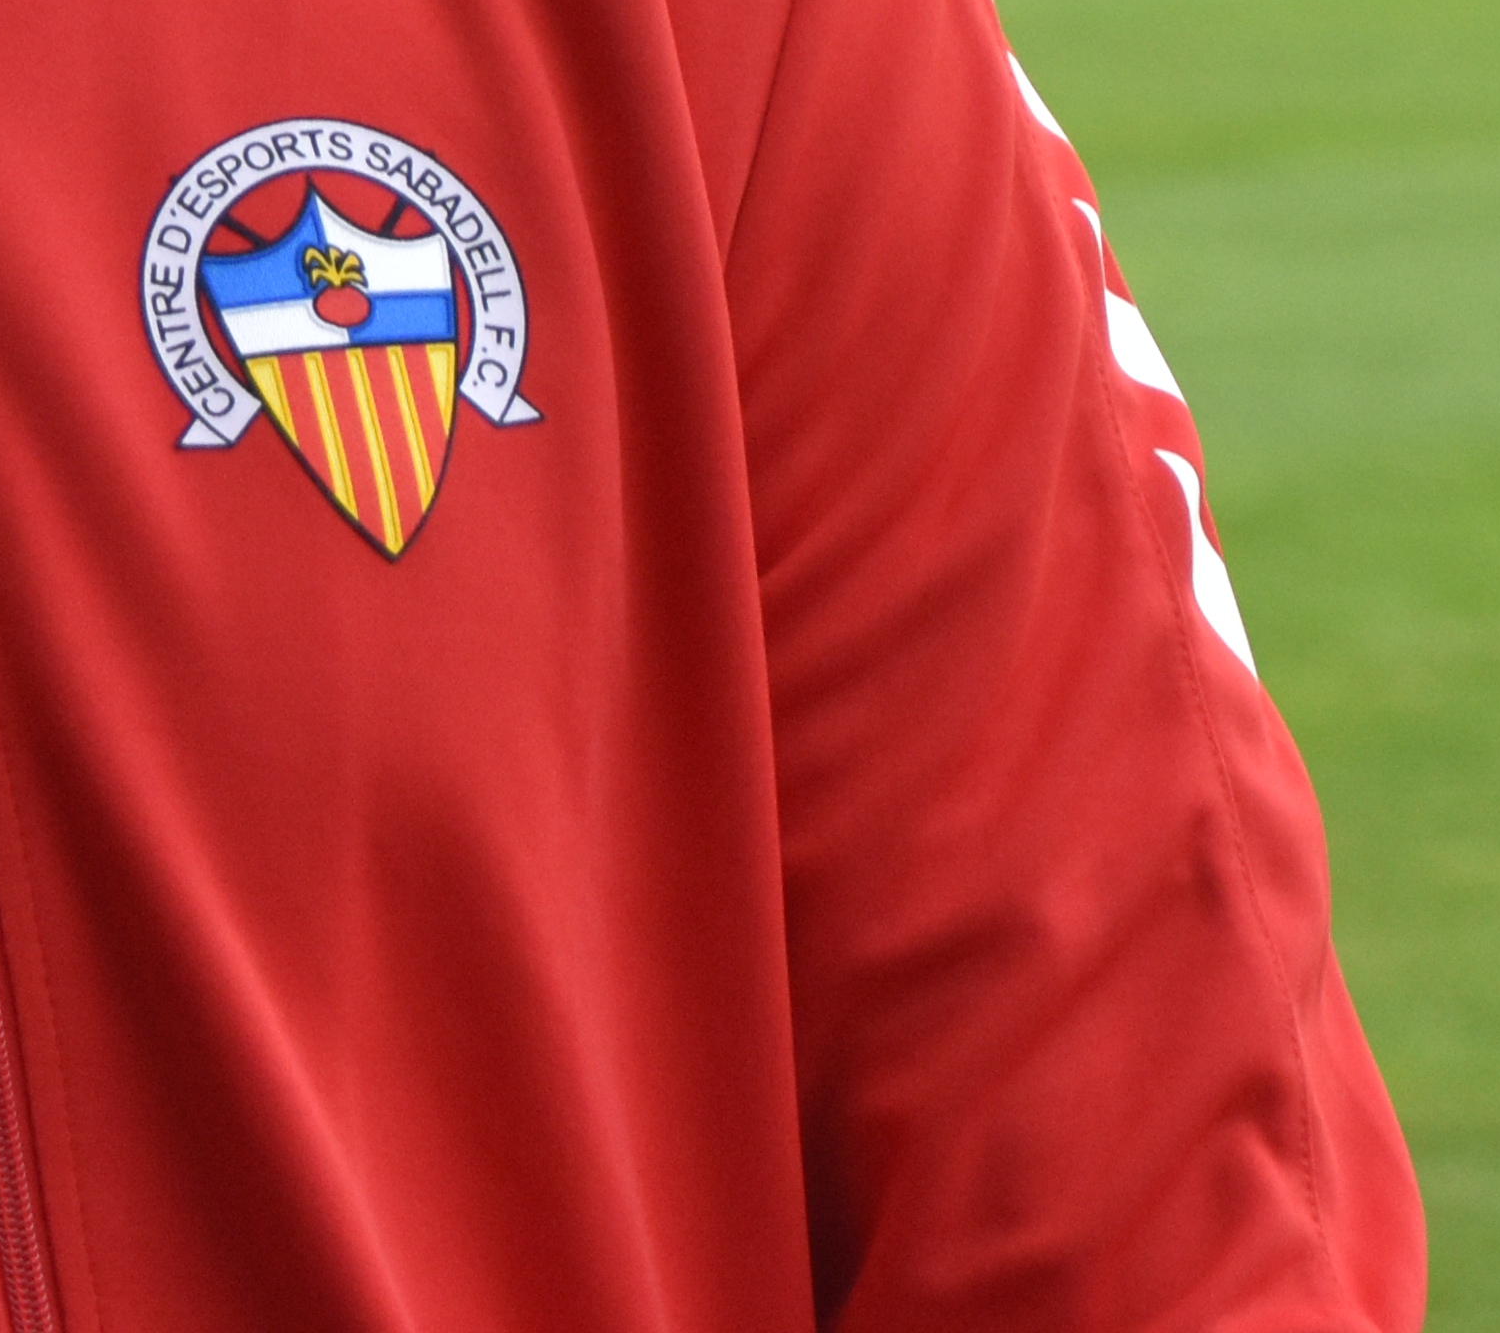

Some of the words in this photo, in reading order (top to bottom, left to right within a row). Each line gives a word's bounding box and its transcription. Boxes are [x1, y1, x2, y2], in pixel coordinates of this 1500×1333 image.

[157, 129, 354, 255] D'ESPORTS
[365, 142, 511, 313] SABADELL
[151, 263, 236, 418] CENTRE
